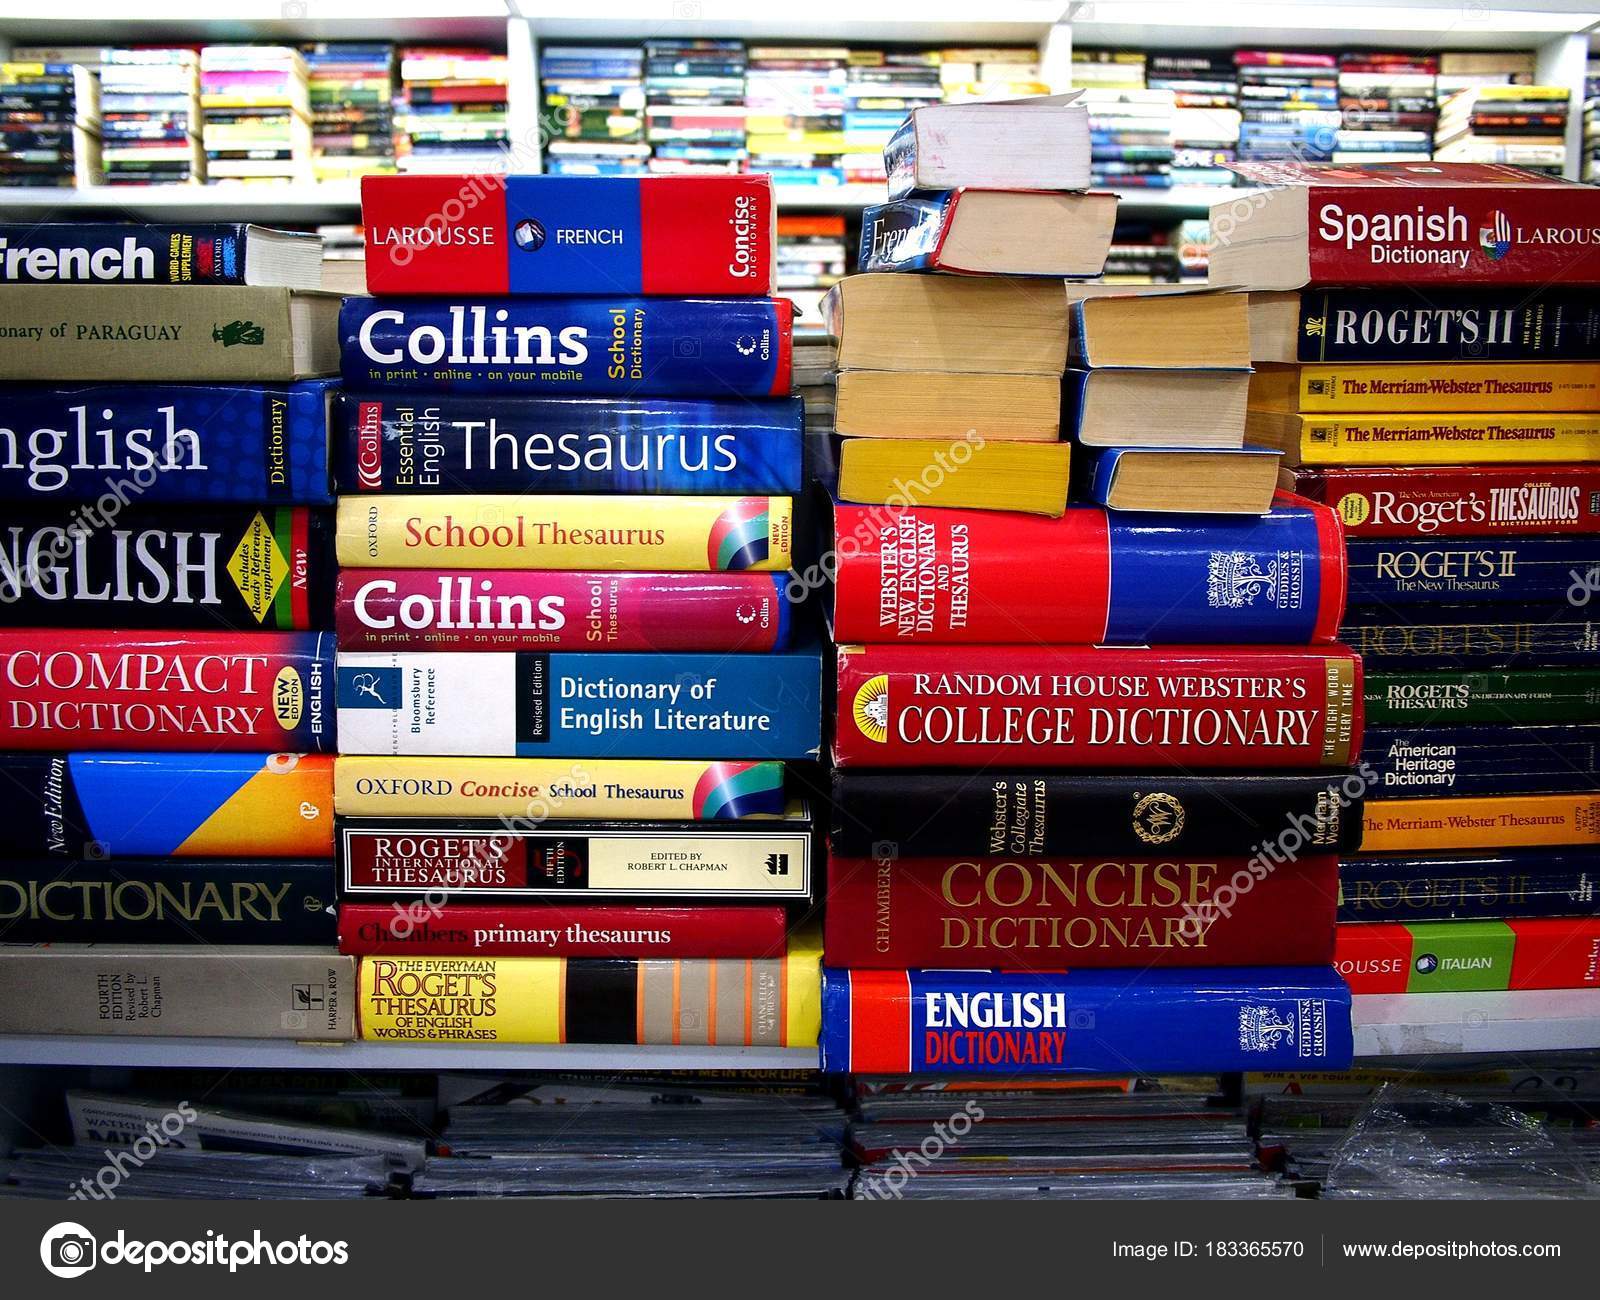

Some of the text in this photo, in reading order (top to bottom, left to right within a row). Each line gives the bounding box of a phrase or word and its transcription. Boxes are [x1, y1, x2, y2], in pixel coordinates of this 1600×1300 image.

[372, 226, 494, 246] LAROUSSE
[556, 228, 623, 245] FRENCH
[729, 195, 750, 278] Concise
[749, 195, 757, 278] DICTIONARY
[1318, 203, 1468, 249] Spanish
[169, 233, 181, 283] WORD-GAMES
[181, 234, 193, 281] SUPPLEMENT
[213, 237, 223, 277] OXFORD
[1371, 244, 1471, 269] Dictionary
[76, 325, 182, 341] PARAGUAY
[358, 306, 589, 365] Collins
[608, 308, 628, 379] School
[630, 308, 647, 379] Dictionary
[760, 328, 770, 361] Collins
[1334, 309, 1480, 344] ROGET'S
[1523, 309, 1532, 345] THE NEW
[1533, 304, 1544, 349] THESAURUS
[369, 370, 583, 383] in print online on your mobile
[1343, 379, 1368, 394] The
[1369, 379, 1482, 394] Merriam-Webster
[1484, 379, 1553, 394] Thesaurus
[270, 399, 287, 485] Dictionary
[396, 407, 414, 485] Essential
[419, 407, 445, 485] English
[452, 418, 737, 472] Thesaurus
[1345, 427, 1370, 441] The
[1372, 426, 1485, 441] Merriam-Webster
[1487, 426, 1555, 440] Thesaurus
[1370, 491, 1486, 532] Roget's
[1489, 486, 1580, 521] THESAURUS
[369, 506, 378, 557] OXFORD
[405, 516, 665, 549] School Thesaurus
[772, 523, 780, 545] NEW
[780, 516, 789, 553] EDITION
[239, 543, 250, 592] Includes
[250, 520, 262, 614] Ready Reference
[262, 535, 273, 601] supplement
[293, 549, 307, 590] New
[898, 515, 916, 637] NEW ENGLISH
[916, 519, 936, 633] DICTIONARY
[937, 564, 949, 592] AND
[950, 524, 969, 630] THESAURUS
[1279, 562, 1289, 608] GEDDES
[1290, 551, 1300, 608] GROSSET
[1395, 578, 1500, 592] The New Thesaurus
[353, 576, 566, 631] Collins
[586, 579, 603, 642] School
[606, 579, 619, 642] Thesaurus
[760, 597, 769, 629] Collins
[381, 632, 560, 645] print online your mobile
[7, 651, 268, 694] COMPACT
[561, 677, 681, 706] Dictionary
[913, 674, 1307, 699] RANDOM HOUSE WEBSTER'S
[1328, 668, 1339, 697] WORD
[277, 677, 290, 719] NEW
[291, 678, 299, 719] EDITION
[311, 663, 322, 734] ENGLISH
[410, 668, 423, 733] Bloomsbury
[425, 668, 435, 724] Reference
[532, 660, 543, 736] Revised Edition
[1340, 683, 1353, 742] EVERY TIME
[1386, 699, 1468, 709] THESAURUS
[9, 700, 265, 735] DICTIONARY
[561, 708, 770, 735] English Literature
[898, 706, 1320, 747] COLLEGE DICTIONARY
[1327, 703, 1338, 733] RIGHT
[1388, 744, 1456, 757] American
[1395, 758, 1455, 772] Heritage
[356, 778, 685, 800] OXFORD Concise School Thesaurus
[1385, 772, 1456, 787] Dictionary
[1011, 782, 1029, 854] Collegiate
[1029, 779, 1046, 855] Thesaurus
[1313, 791, 1327, 845] Merriam
[1325, 791, 1340, 845] Webster
[1361, 814, 1565, 831] The Merriam-Webster Thesaurus
[372, 868, 506, 885] THESAURUS
[375, 858, 503, 870] INTERNATIONAL
[546, 847, 554, 877] FIFTH
[556, 841, 565, 884] EDITION
[627, 863, 728, 872] ROBERT CHAPMAN
[650, 852, 702, 861] EDITED BY
[0, 880, 292, 921] DICTIONARY
[876, 857, 891, 952] CHAMBERS
[941, 862, 1219, 908] CONCISE
[474, 924, 671, 948] primary thesaurus
[941, 917, 1219, 949] DICTIONARY
[397, 961, 496, 972] THE EVERYMAN
[1441, 956, 1492, 970] ITALIAN
[97, 974, 110, 1019] FOURTH
[110, 974, 122, 1019] EDITION
[124, 988, 136, 1020] Revised
[138, 989, 149, 1018] Robert
[151, 976, 163, 1018] Chapman
[328, 968, 337, 1030] HARPER ROW
[371, 998, 497, 1016] THESAURUS
[925, 992, 1067, 1028] ENGLISH
[373, 1028, 497, 1040] WORDS PHRASES
[395, 1017, 473, 1028] OF ENGLISH
[1302, 1008, 1311, 1056] GEDDES
[1313, 1000, 1322, 1056] GROSSET
[925, 1031, 1066, 1064] DICTIONARY
